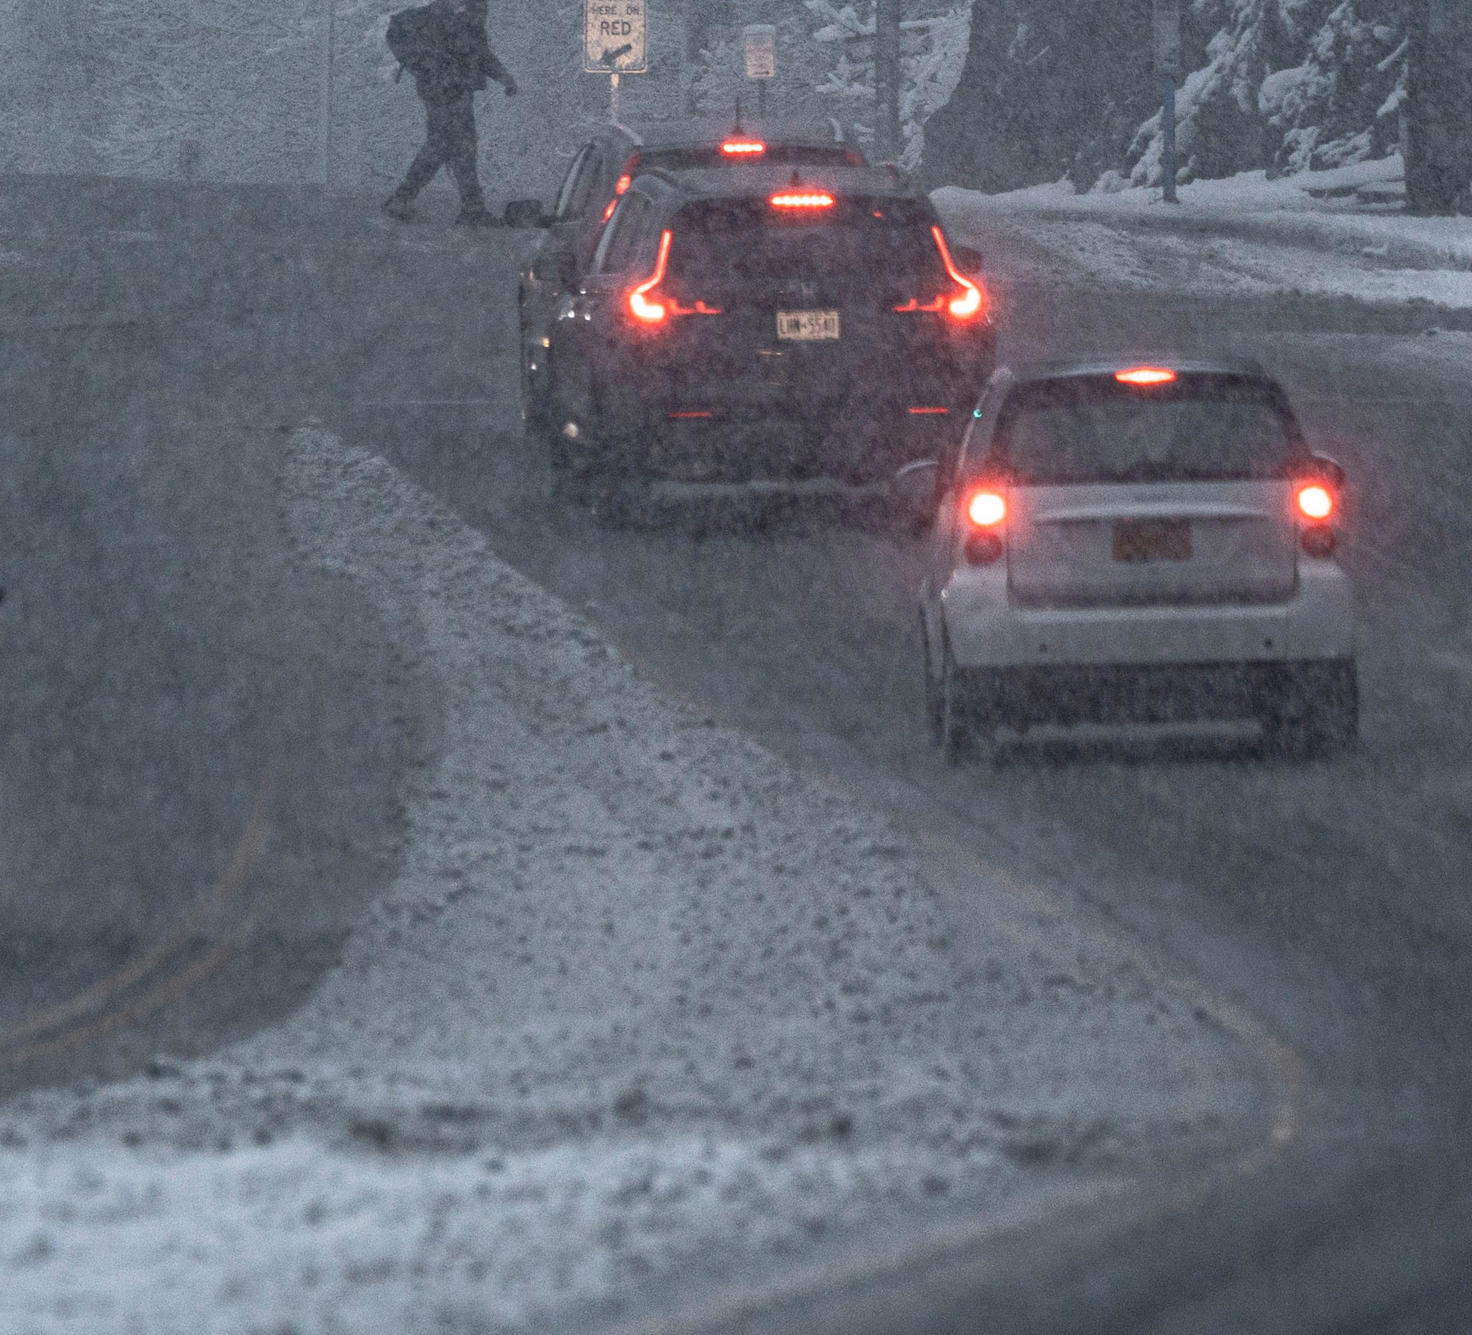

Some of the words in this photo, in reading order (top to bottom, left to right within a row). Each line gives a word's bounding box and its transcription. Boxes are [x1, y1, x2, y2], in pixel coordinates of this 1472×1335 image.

[591, 5, 617, 16] HERE
[626, 4, 640, 16] ON
[600, 20, 632, 36] RED
